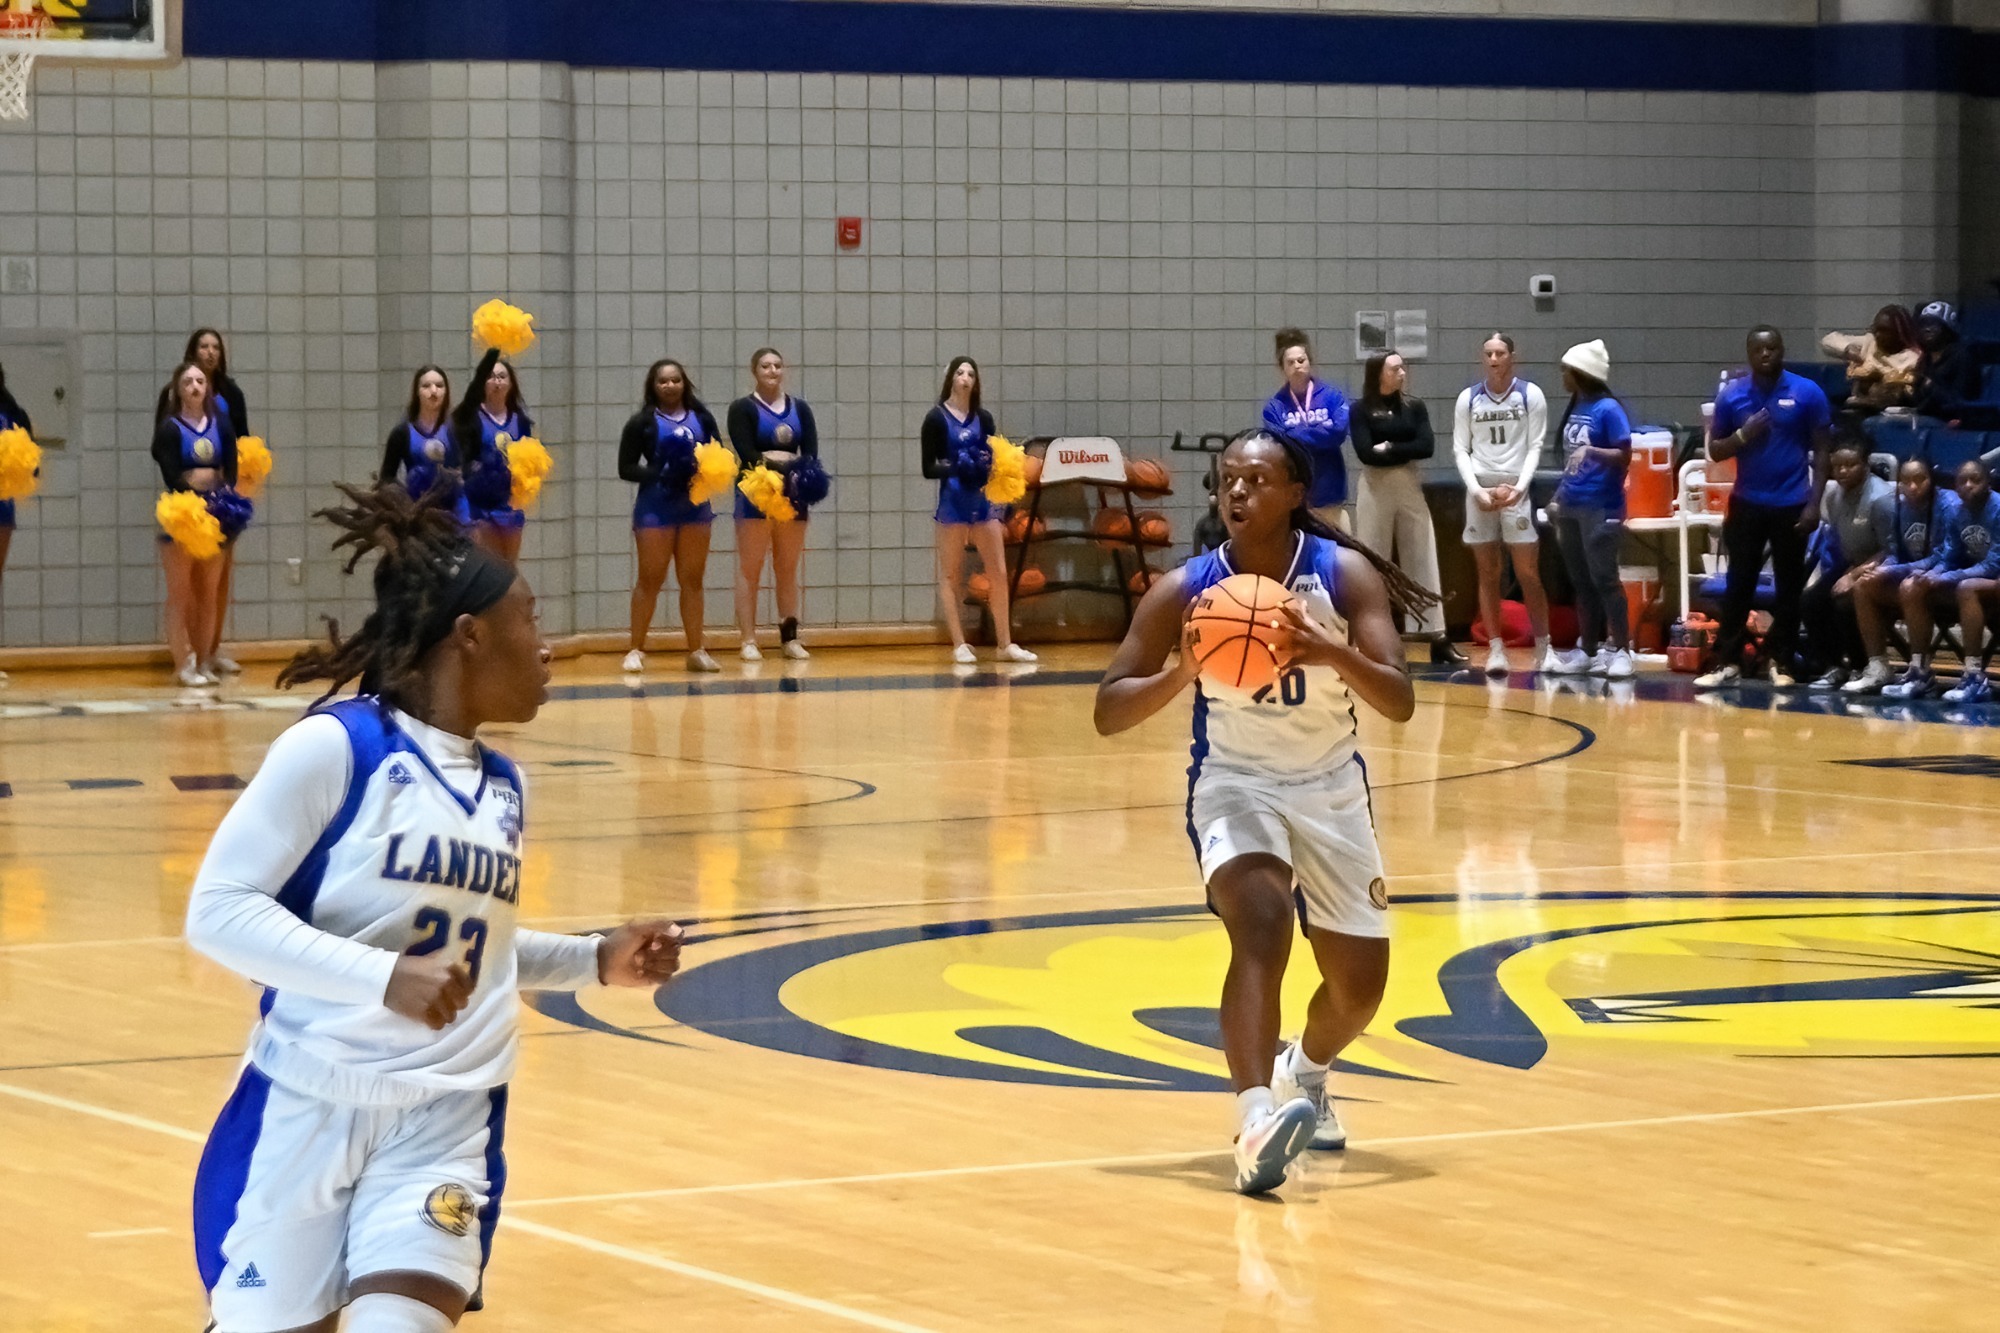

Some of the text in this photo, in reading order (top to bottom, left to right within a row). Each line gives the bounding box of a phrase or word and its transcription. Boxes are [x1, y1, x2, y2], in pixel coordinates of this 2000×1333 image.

[1490, 425, 1506, 445] 11
[1058, 449, 1110, 465] Wilson
[405, 906, 488, 985] 23
